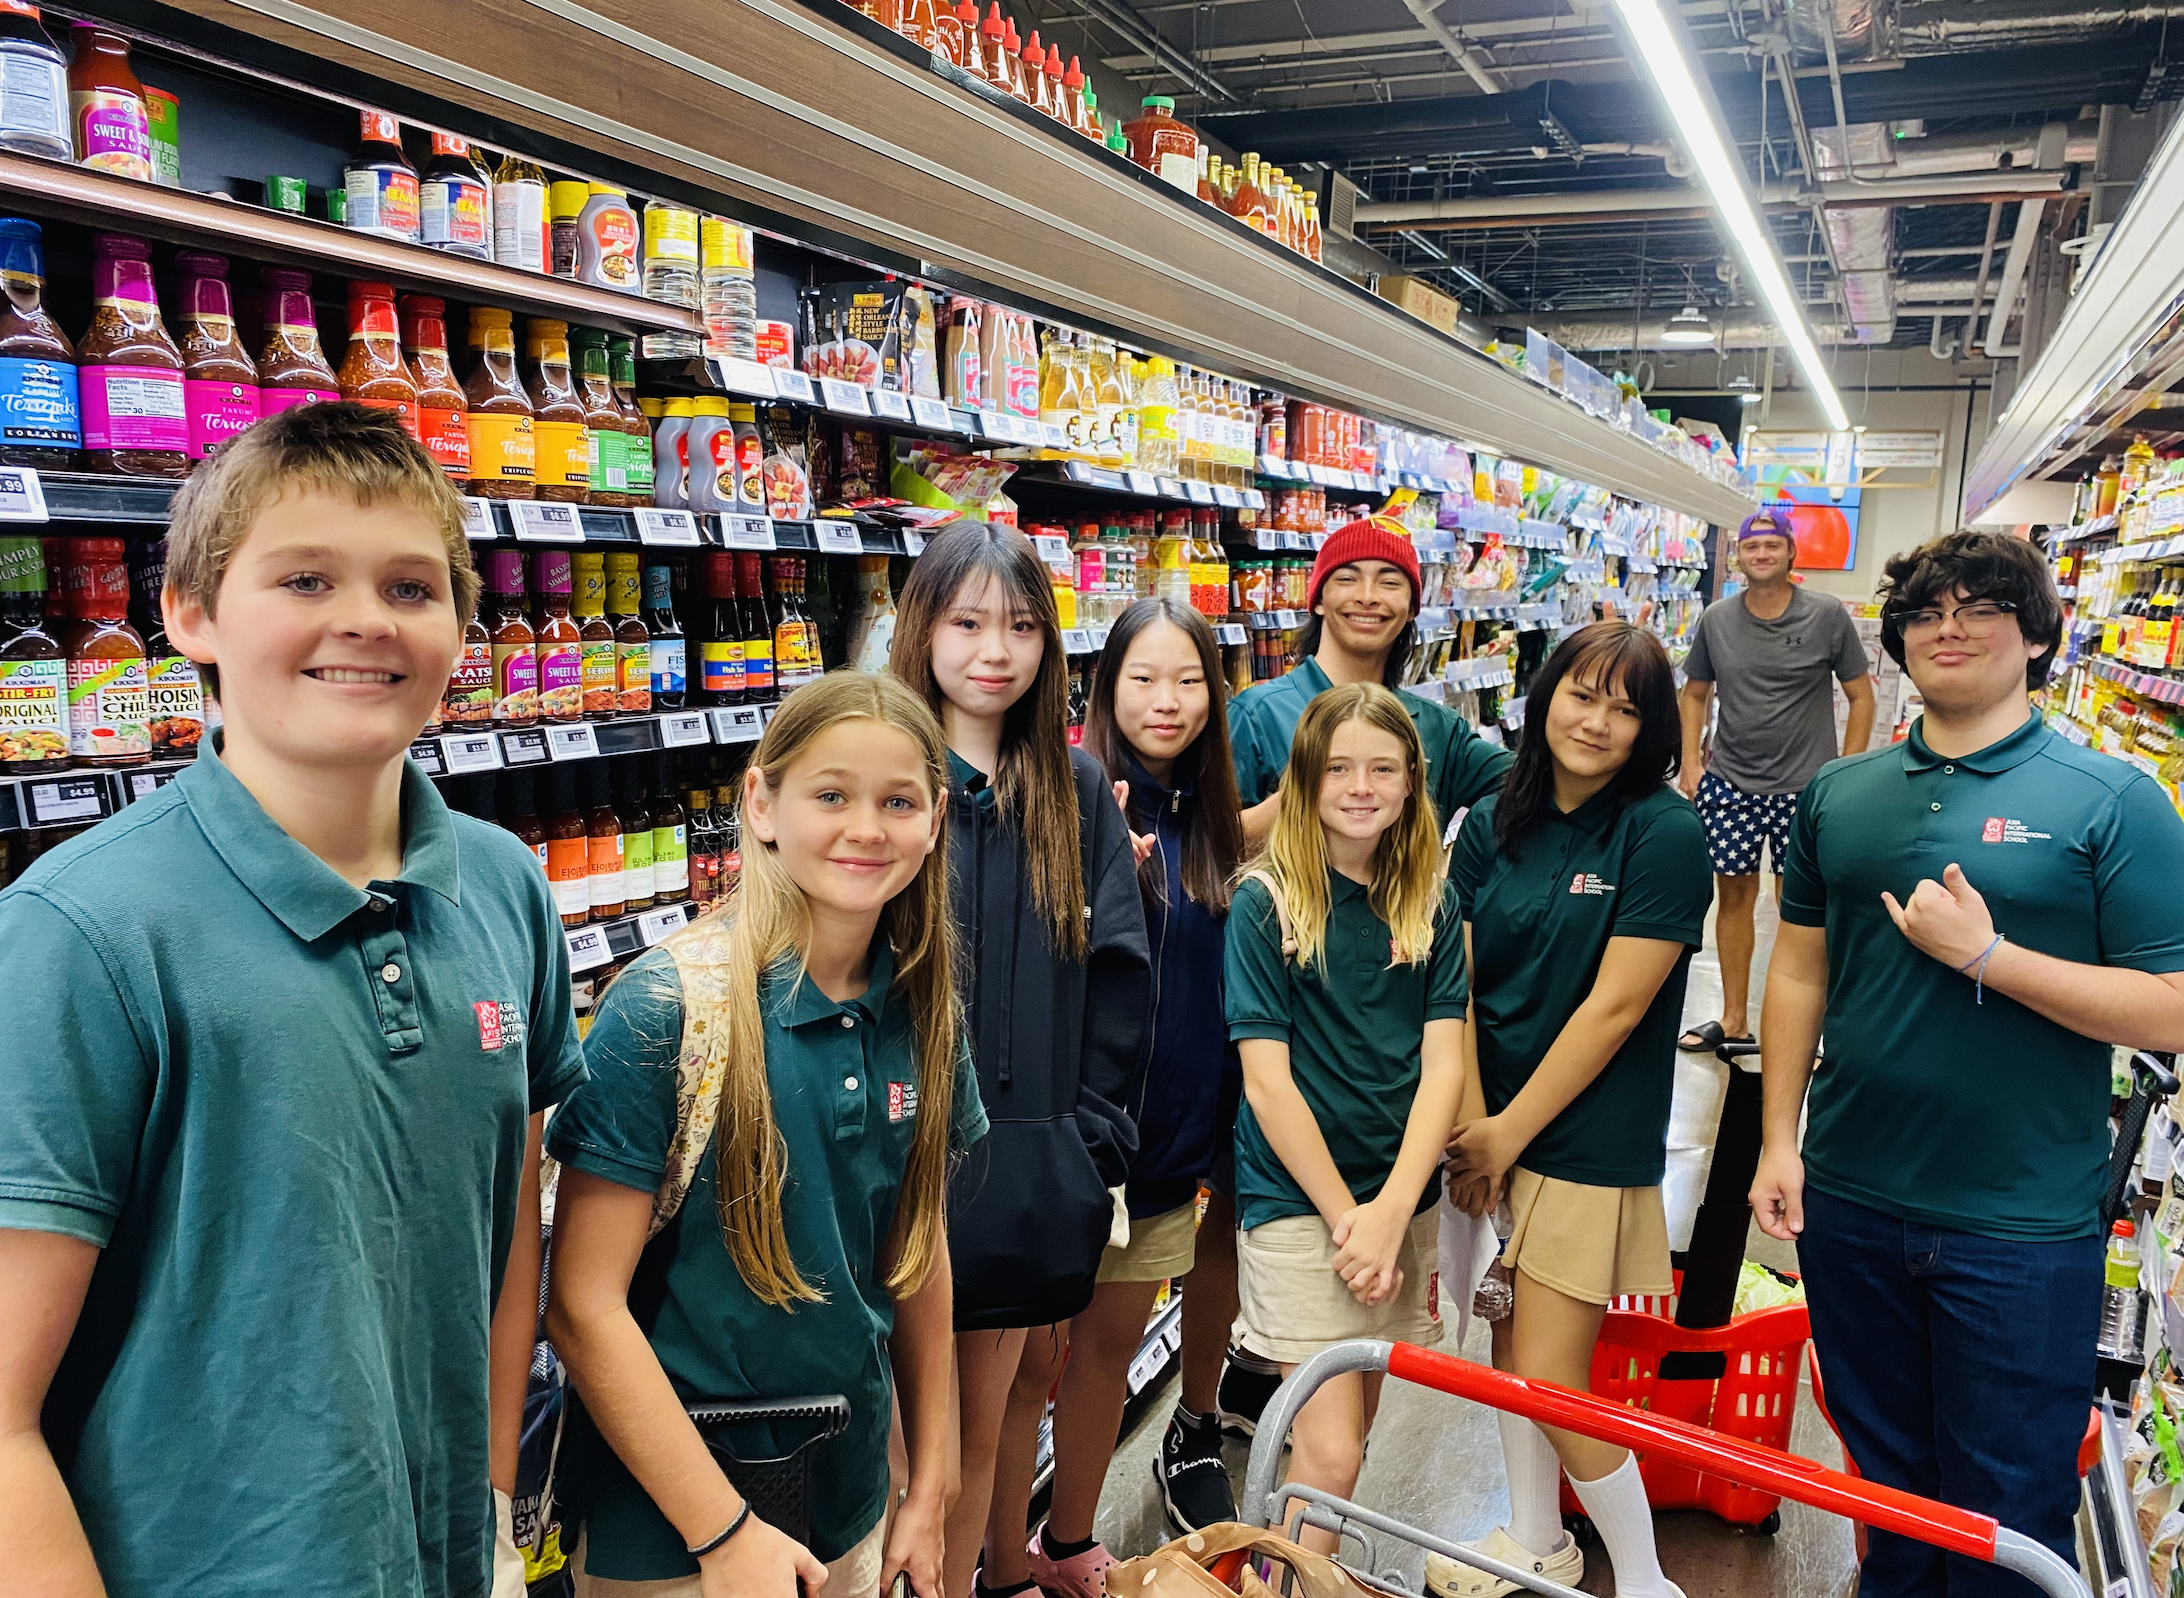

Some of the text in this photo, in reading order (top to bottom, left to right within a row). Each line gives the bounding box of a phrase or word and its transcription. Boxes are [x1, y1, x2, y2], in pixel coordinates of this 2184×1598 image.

[94, 124, 126, 141] SWEET
[128, 130, 136, 143] &
[109, 140, 148, 156] SAUCE
[863, 323, 884, 331] STYLE
[1833, 450, 1845, 468] 5
[550, 511, 571, 521] $6.99
[670, 518, 688, 528] $6.99
[0, 546, 40, 568] IMPLY
[668, 656, 685, 667] FIS
[452, 667, 491, 681] KATS
[513, 668, 532, 681] SWEET
[548, 666, 570, 680] SWEET
[722, 667, 735, 676] Fish
[5, 679, 48, 687] KIKKOMAN
[157, 675, 193, 683] KIKKOMAN
[0, 687, 55, 701] STIR-FRY
[102, 694, 148, 702] SWEET
[148, 688, 200, 705] HOISIN
[0, 703, 57, 718] ORIGINAL
[103, 702, 149, 715] CHIL
[149, 703, 200, 717] SAUCE
[70, 787, 95, 798] $4.99
[2004, 831, 2052, 839] INTERNATIONAL
[577, 938, 598, 950] $4.99
[482, 1029, 500, 1040] APIS
